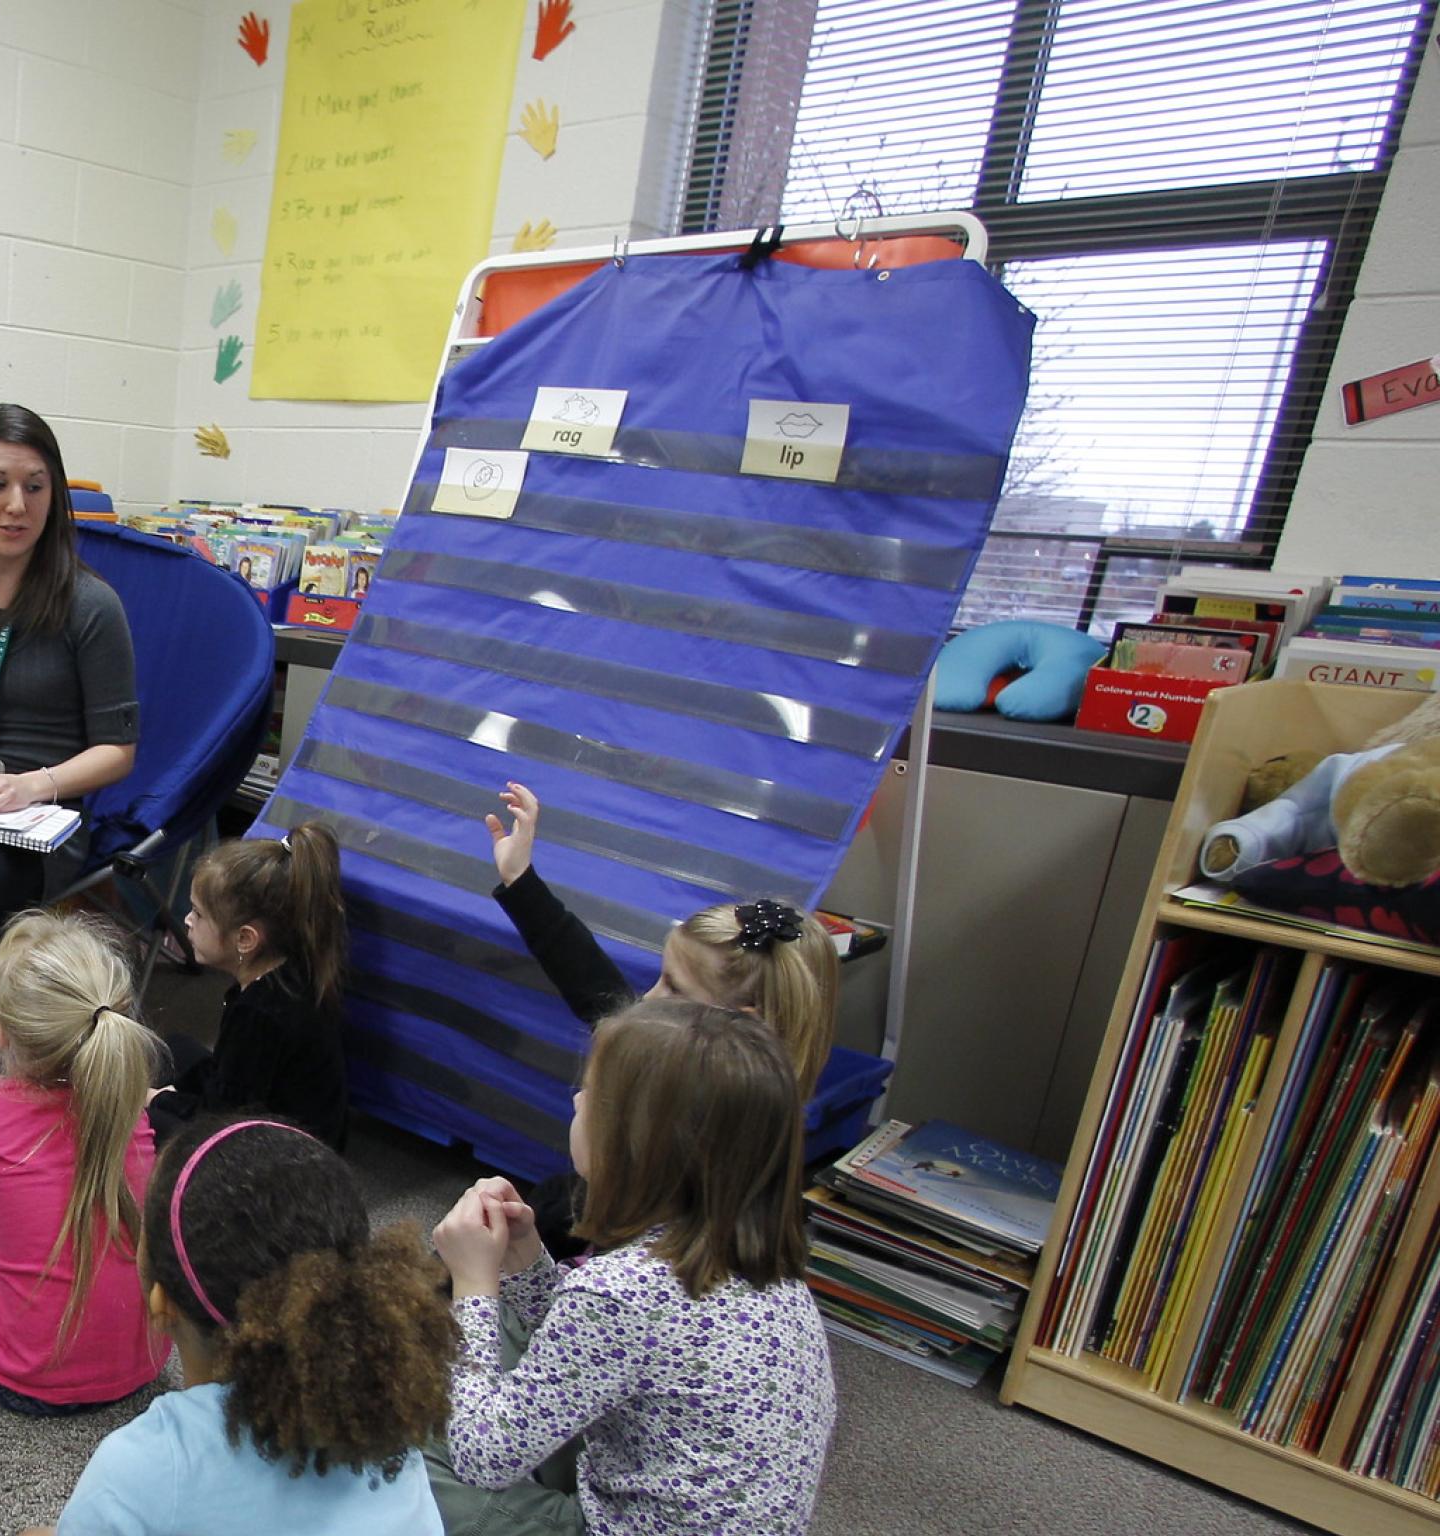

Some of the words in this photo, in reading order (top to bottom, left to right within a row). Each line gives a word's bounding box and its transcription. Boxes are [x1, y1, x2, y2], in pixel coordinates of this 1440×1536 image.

[552, 429, 582, 447] rag
[779, 445, 805, 470] lip
[1308, 664, 1405, 686] GIANT
[1094, 683, 1133, 695] Colors
[1135, 689, 1158, 699] and
